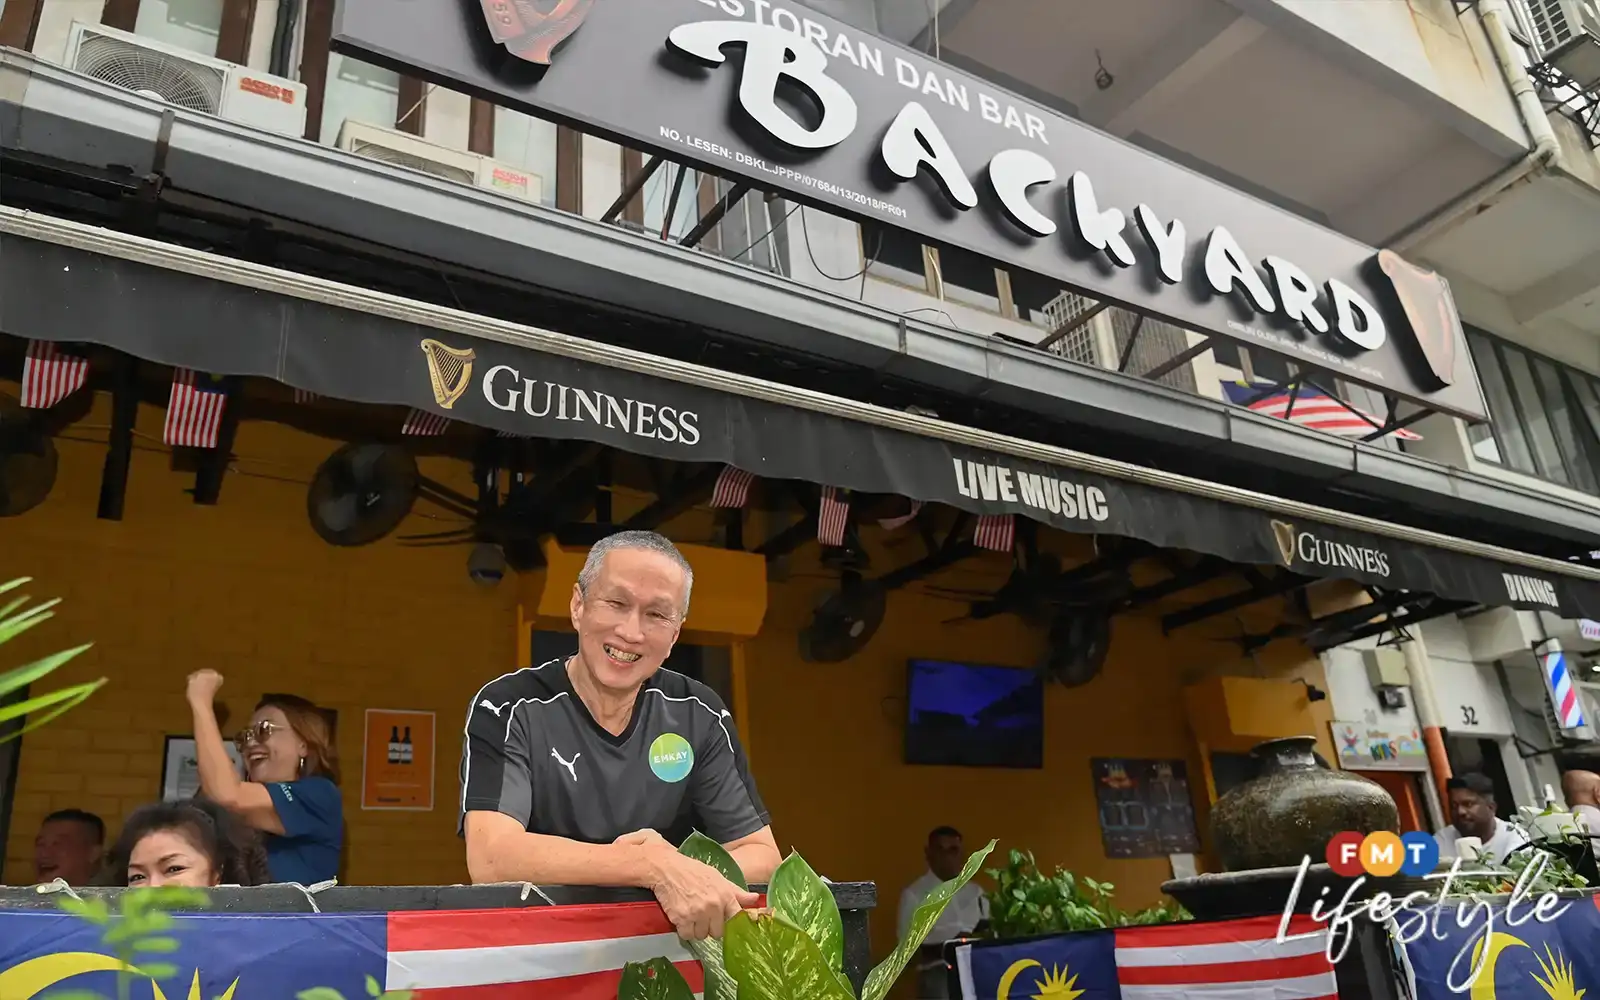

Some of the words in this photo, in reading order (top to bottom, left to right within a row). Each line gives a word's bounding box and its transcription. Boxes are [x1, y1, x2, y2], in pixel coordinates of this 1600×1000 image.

[698, 0, 885, 76] STORAN
[895, 57, 970, 112] DAN
[978, 92, 1050, 146] BAR
[659, 125, 684, 143] NO.
[686, 135, 733, 160] LESEN:
[481, 364, 701, 446] GUINNESS
[952, 457, 1019, 503] LIVE
[1016, 470, 1110, 522] MUSIC
[1297, 531, 1391, 578] GUINNESS
[1501, 572, 1560, 608] DINING
[1460, 705, 1478, 726] 32
[653, 750, 688, 764] EMKAY
